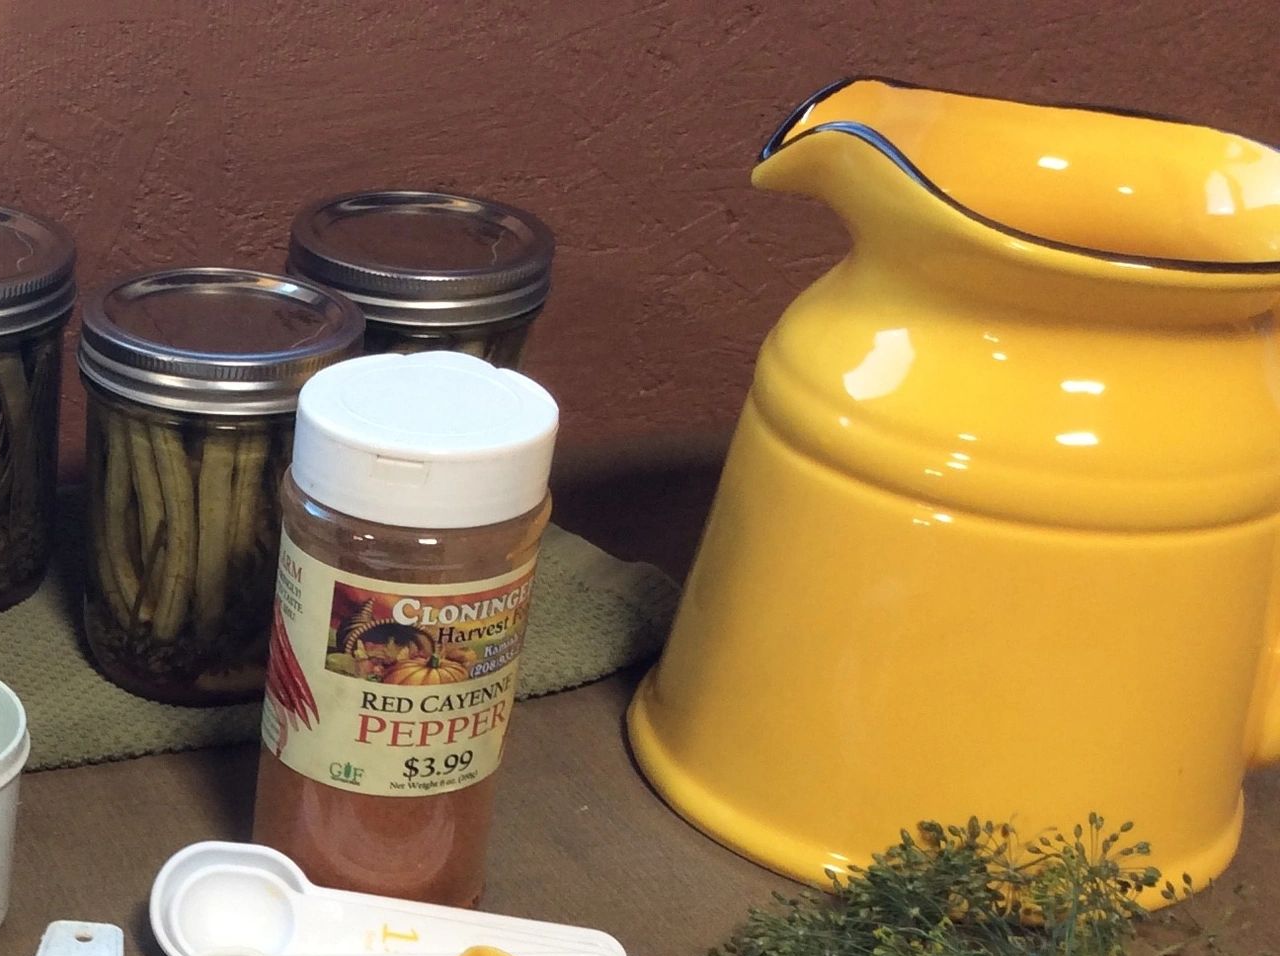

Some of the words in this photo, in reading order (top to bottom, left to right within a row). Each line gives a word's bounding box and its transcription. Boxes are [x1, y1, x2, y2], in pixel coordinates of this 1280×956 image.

[437, 615, 509, 645] Harvest
[360, 691, 413, 714] RED
[354, 701, 506, 748] PEPPER
[403, 750, 473, 781] $3.99
[408, 778, 439, 791] Weight
